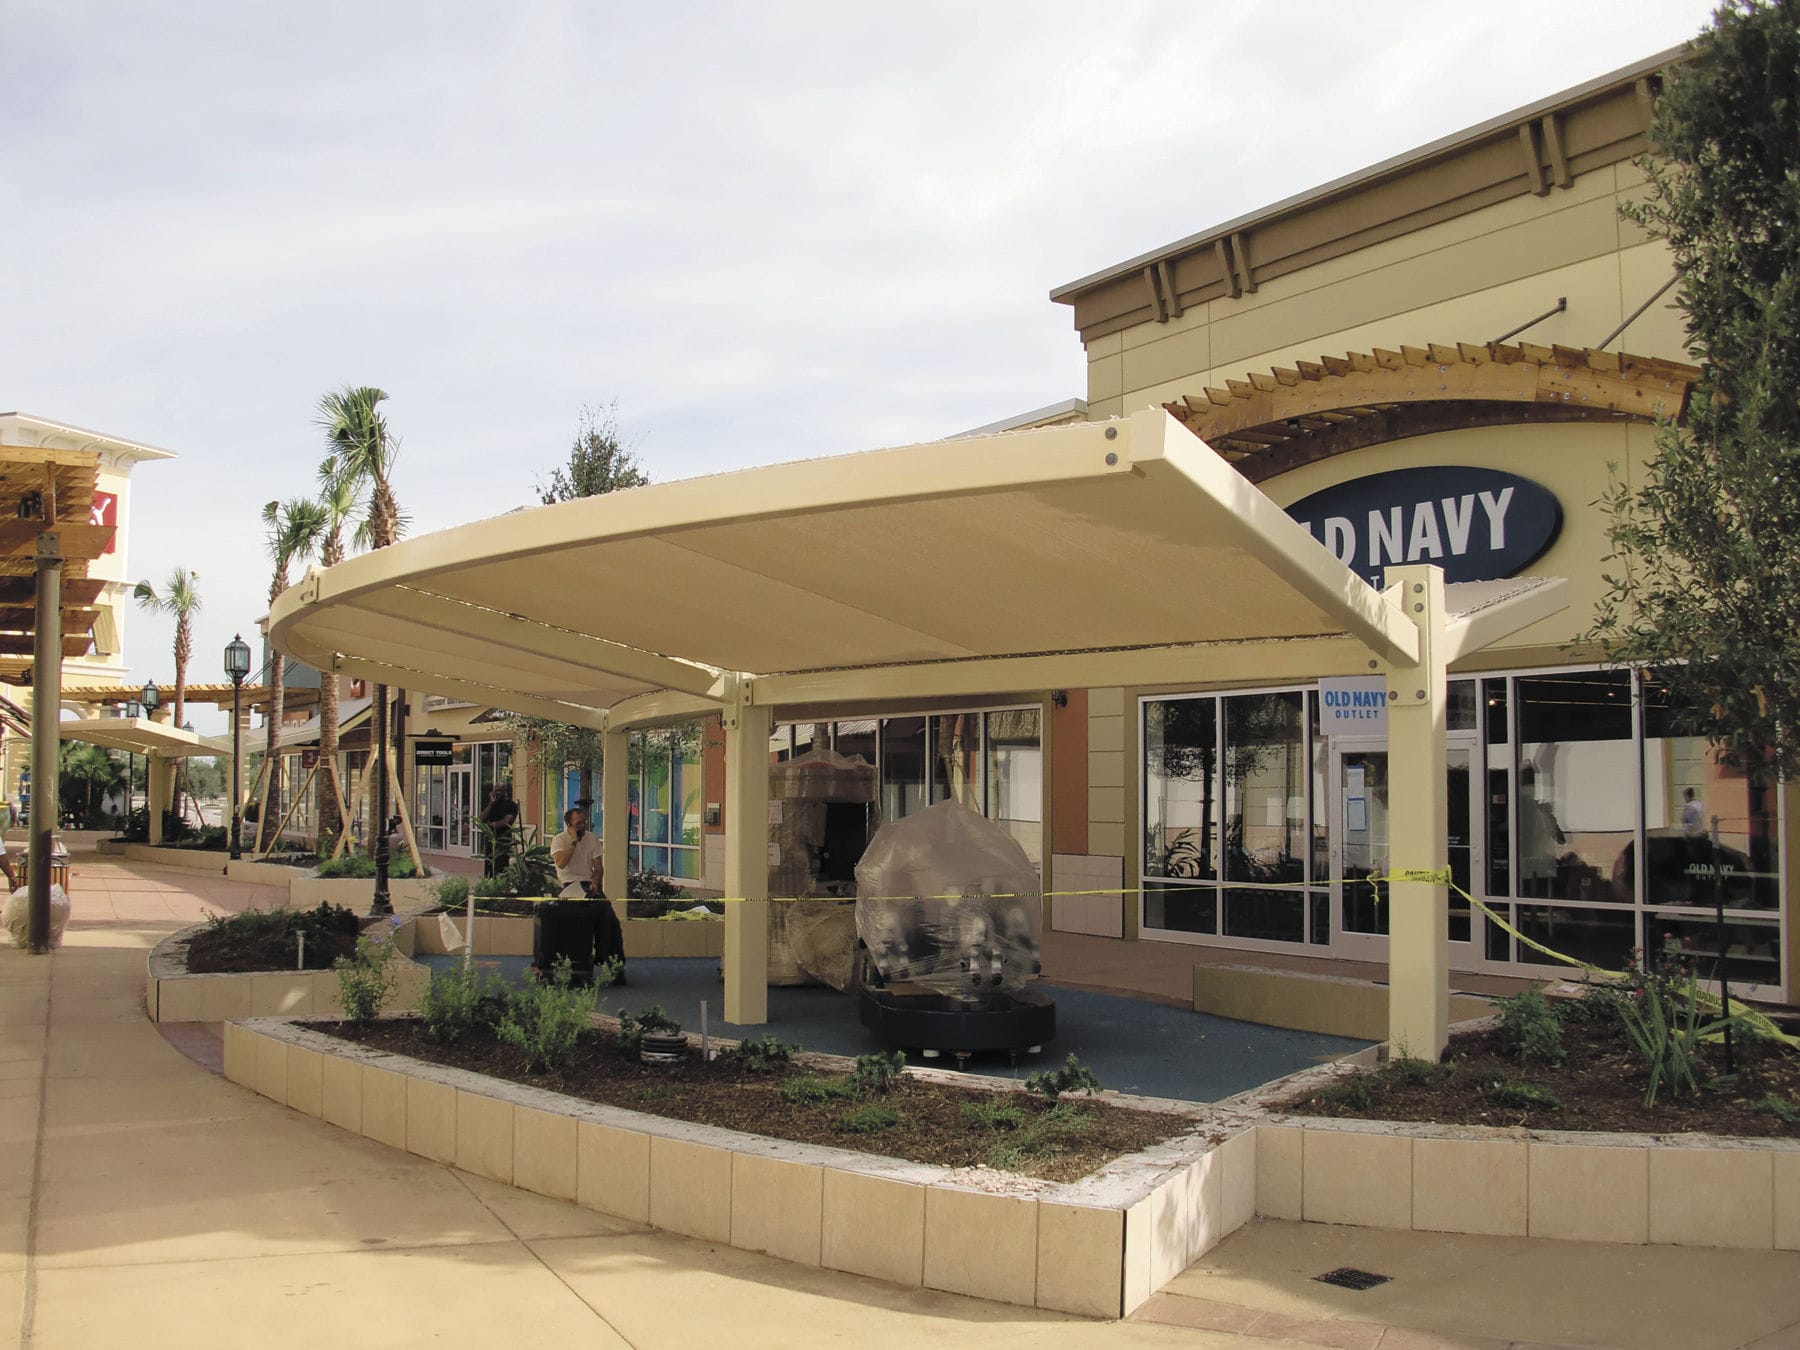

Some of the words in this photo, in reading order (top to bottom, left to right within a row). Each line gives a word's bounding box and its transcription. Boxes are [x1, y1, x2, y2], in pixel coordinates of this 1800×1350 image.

[1368, 486, 1515, 567] NAVY
[1324, 690, 1351, 707] OLD
[1352, 691, 1387, 707] NAVY
[1335, 709, 1379, 719] OUTLET
[1689, 863, 1708, 874] OLD
[1709, 864, 1735, 875] NVY
